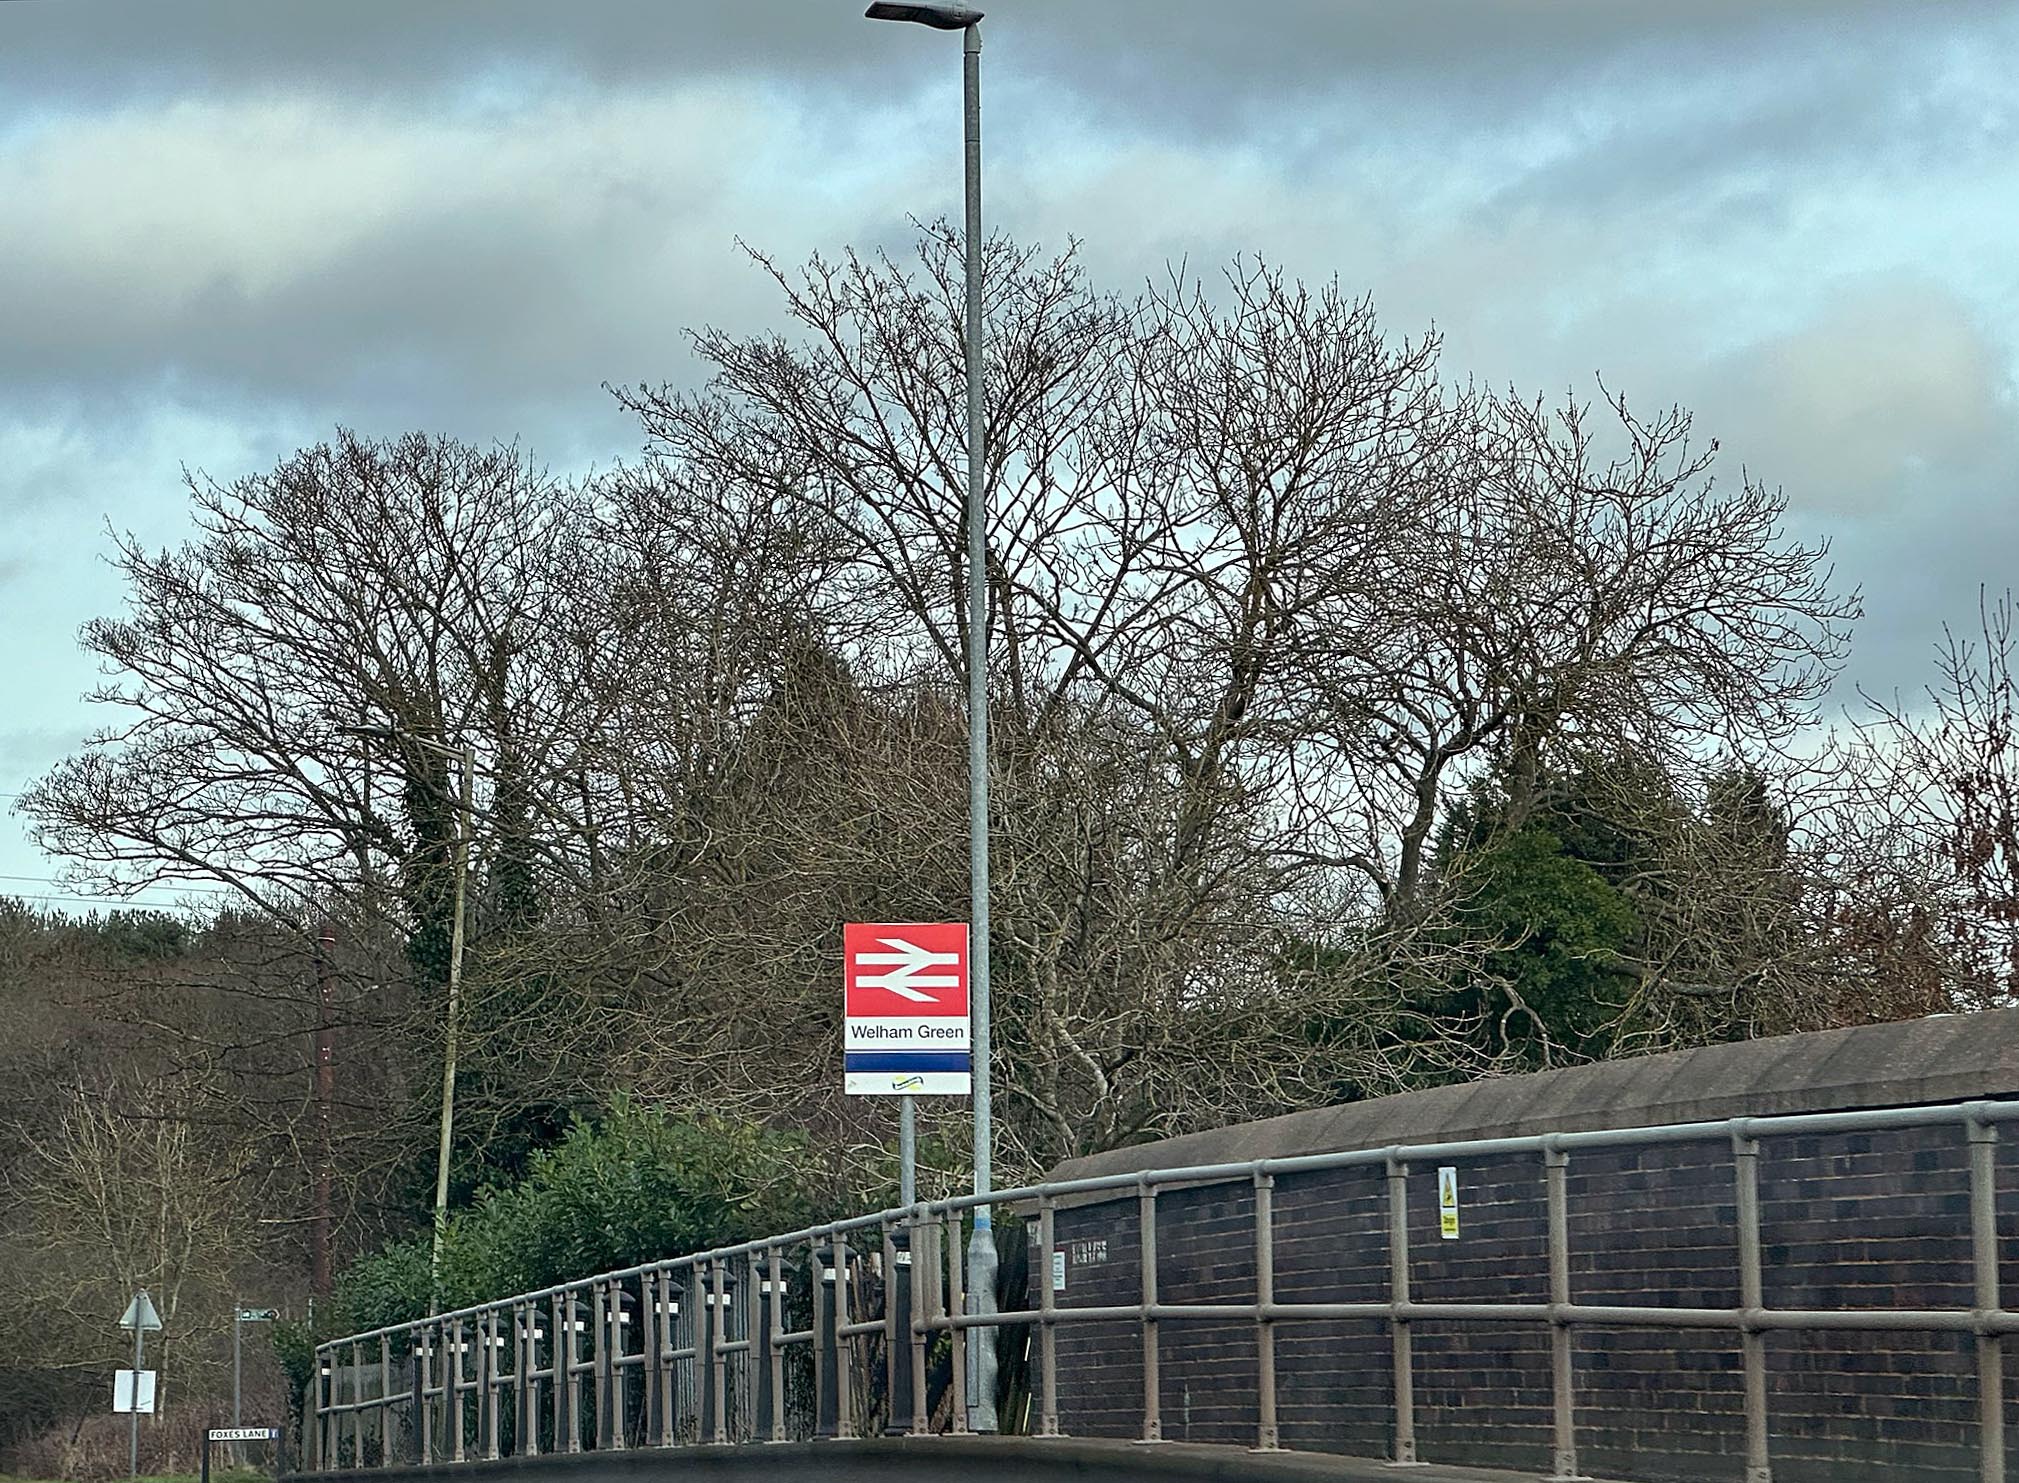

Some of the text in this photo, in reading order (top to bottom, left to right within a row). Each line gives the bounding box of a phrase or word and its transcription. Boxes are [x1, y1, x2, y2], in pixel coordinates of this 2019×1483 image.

[851, 1024, 964, 1039] Welham Green
[210, 1430, 267, 1439] FOXES LANE
